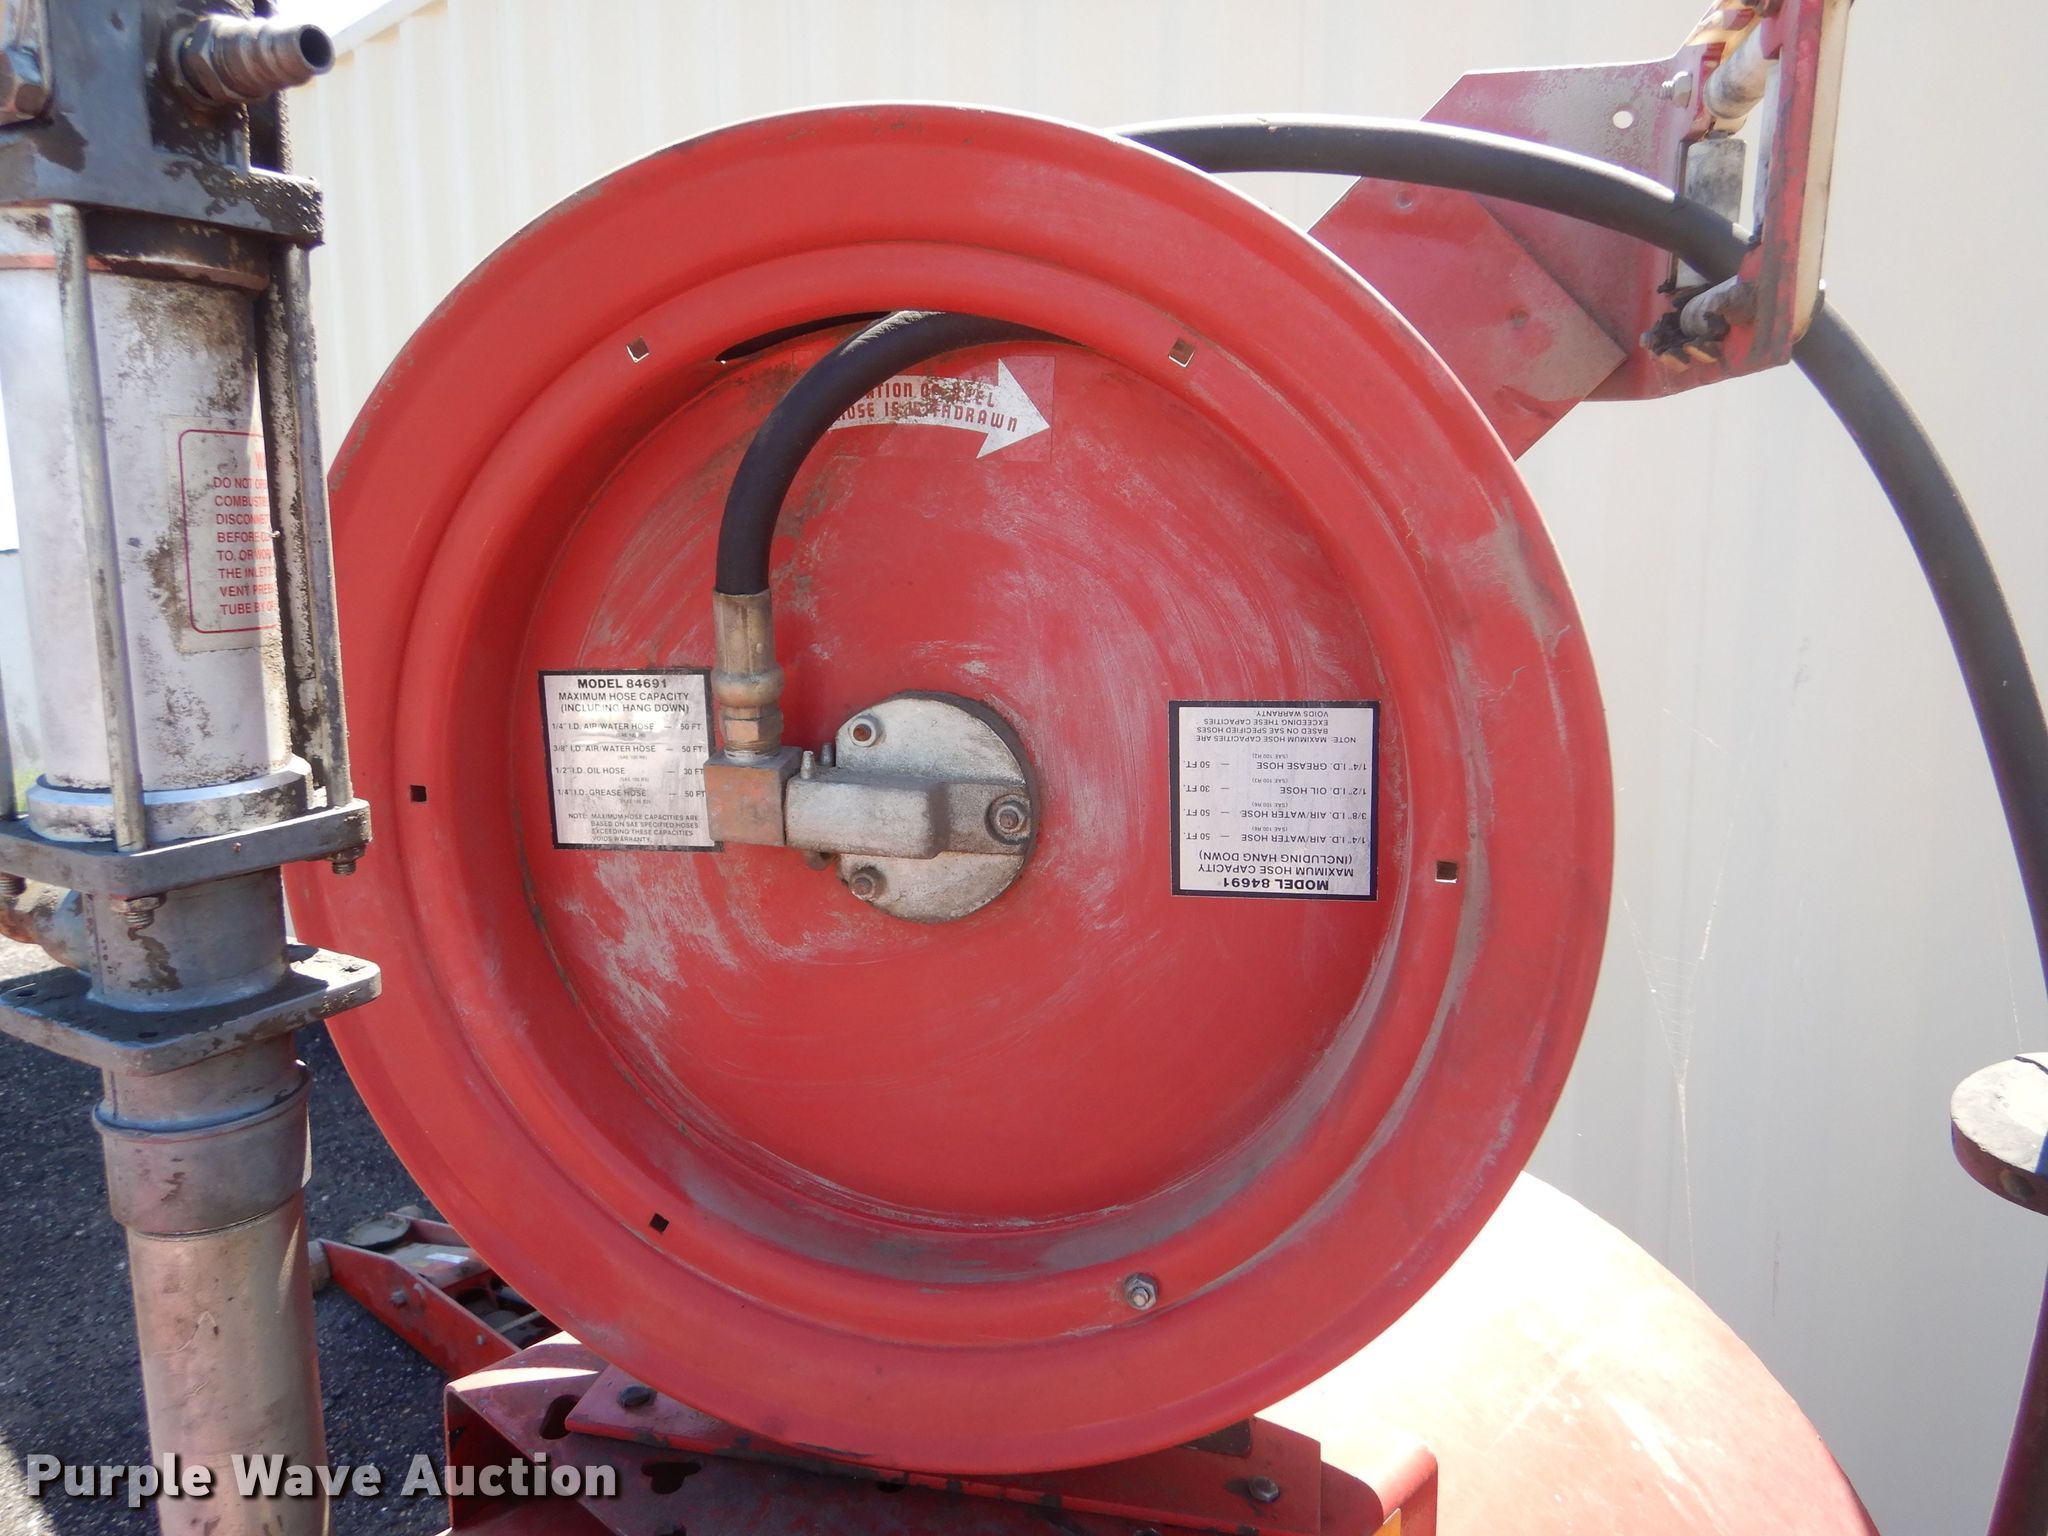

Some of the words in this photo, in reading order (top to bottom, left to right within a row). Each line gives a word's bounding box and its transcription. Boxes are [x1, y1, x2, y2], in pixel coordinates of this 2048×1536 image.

[838, 402, 875, 421] OSE
[213, 477, 231, 489] DO
[235, 478, 252, 489] NOT
[217, 532, 259, 543] BEFORE
[240, 549, 254, 561] OR
[217, 568, 241, 579] THE
[219, 585, 250, 597] VENT
[220, 603, 252, 615] TUBE
[578, 679, 623, 688] MODEL
[626, 678, 667, 688] 84691
[558, 692, 606, 701] MAXIMUM
[609, 692, 636, 701] HOSE
[639, 692, 689, 701] CAPACITY
[561, 704, 619, 713] (INCLUDING
[623, 704, 651, 712] HANG
[654, 704, 690, 713] DOWN)
[1241, 810, 1268, 818] HOSE
[1271, 811, 1326, 819] AIR/WATER
[1241, 834, 1268, 842] HOSE
[1271, 835, 1326, 843] AIR/WATER
[1199, 850, 1239, 861] DOWN)
[1243, 853, 1276, 861] HANG
[1281, 854, 1352, 864] (INCLUDING
[1198, 864, 1255, 873] CAPACITY
[1260, 866, 1291, 874] HOSE
[1296, 867, 1353, 876] MAXIMUM
[1223, 878, 1270, 888] 84691
[1275, 879, 1328, 890] MODEL
